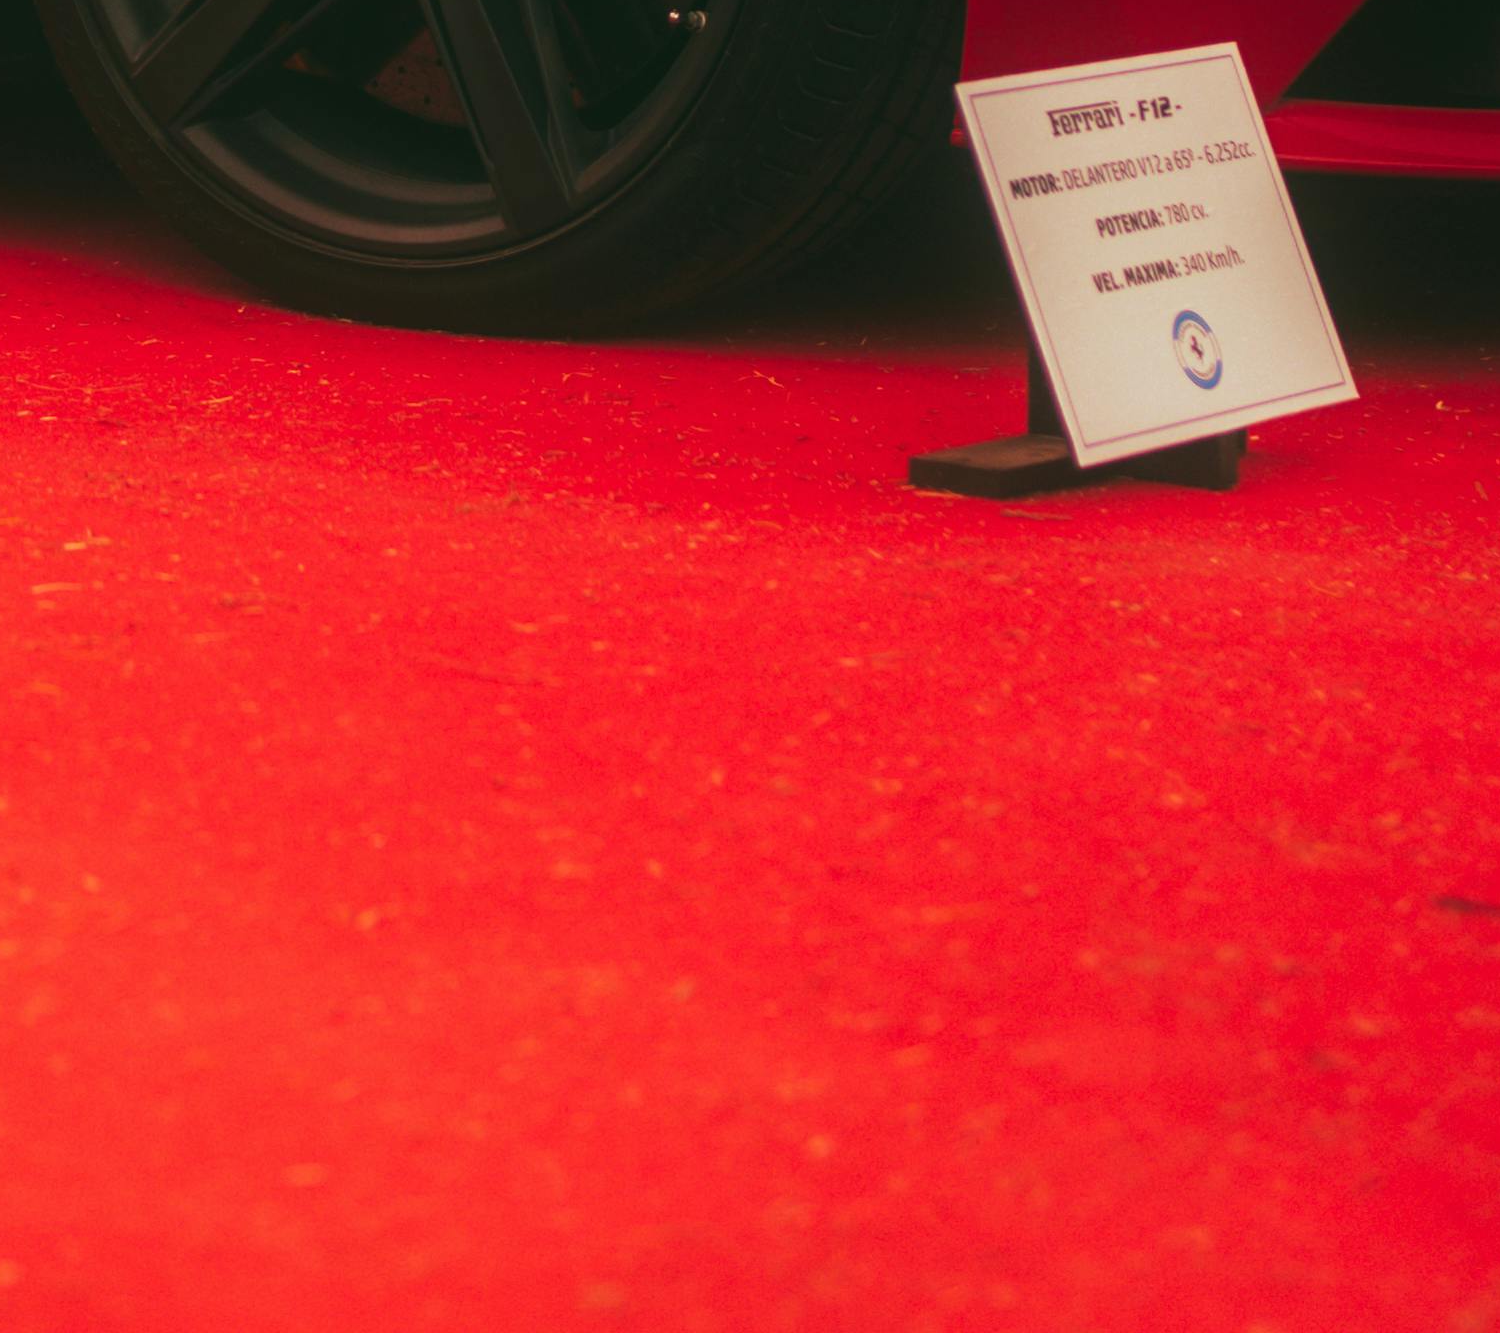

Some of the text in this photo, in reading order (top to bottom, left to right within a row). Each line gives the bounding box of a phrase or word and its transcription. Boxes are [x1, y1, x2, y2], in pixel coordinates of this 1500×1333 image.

[1046, 100, 1125, 137] Ferrari
[1009, 173, 1064, 200] MOTOR:
[1062, 160, 1137, 191] DELANTERO
[1138, 155, 1162, 177] V12
[1165, 157, 1174, 171] a
[1204, 140, 1257, 164] 6.252cc.
[1095, 202, 1209, 238] POTENCIA: 780 cv.
[1091, 245, 1245, 293] VEL. MAXIMA: 340 Km/h.
